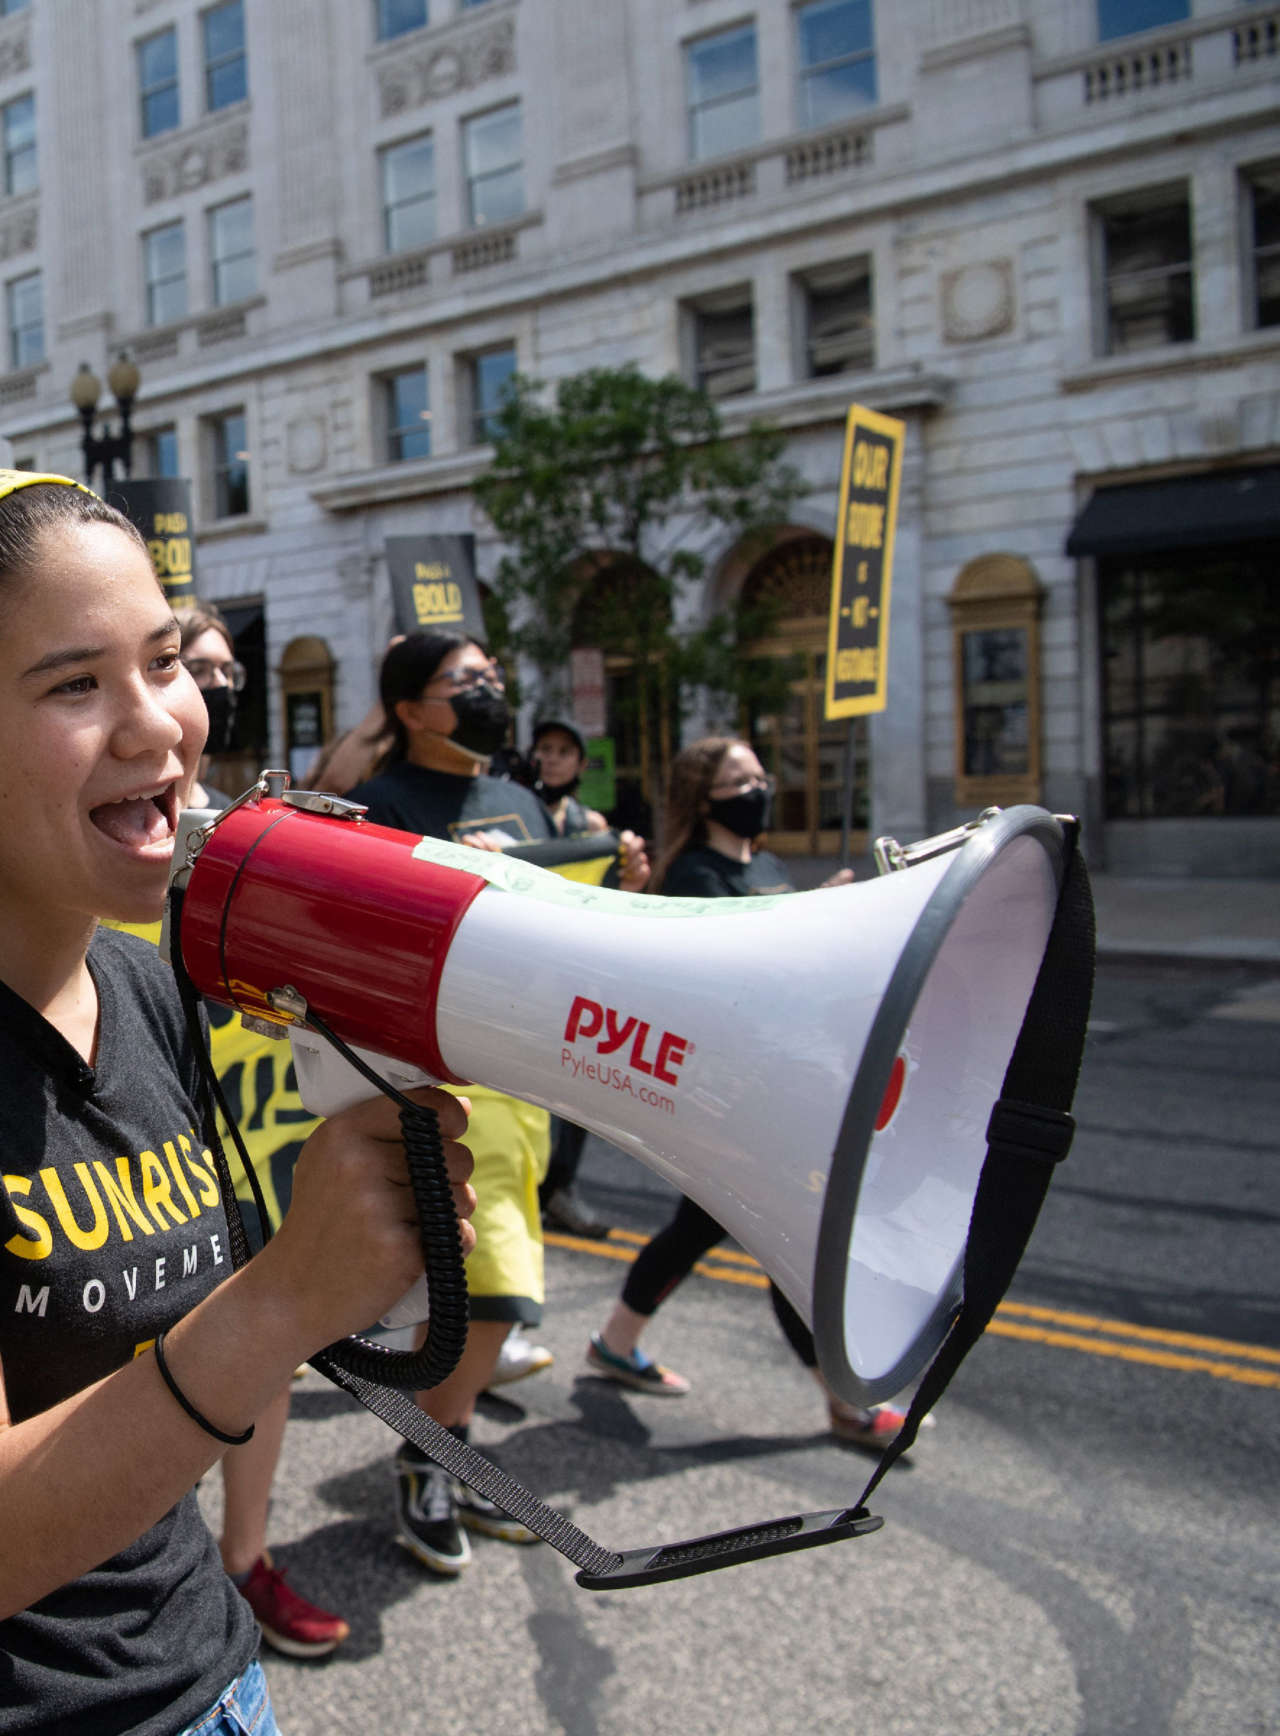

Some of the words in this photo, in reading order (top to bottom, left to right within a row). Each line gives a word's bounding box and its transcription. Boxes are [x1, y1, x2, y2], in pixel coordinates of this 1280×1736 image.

[412, 583, 463, 615] BOLD
[561, 1047, 676, 1115] PyleUSA.com
[563, 995, 688, 1087] PYLE
[4, 1129, 221, 1260] SUNRIS
[14, 1234, 224, 1317] MOVEME
